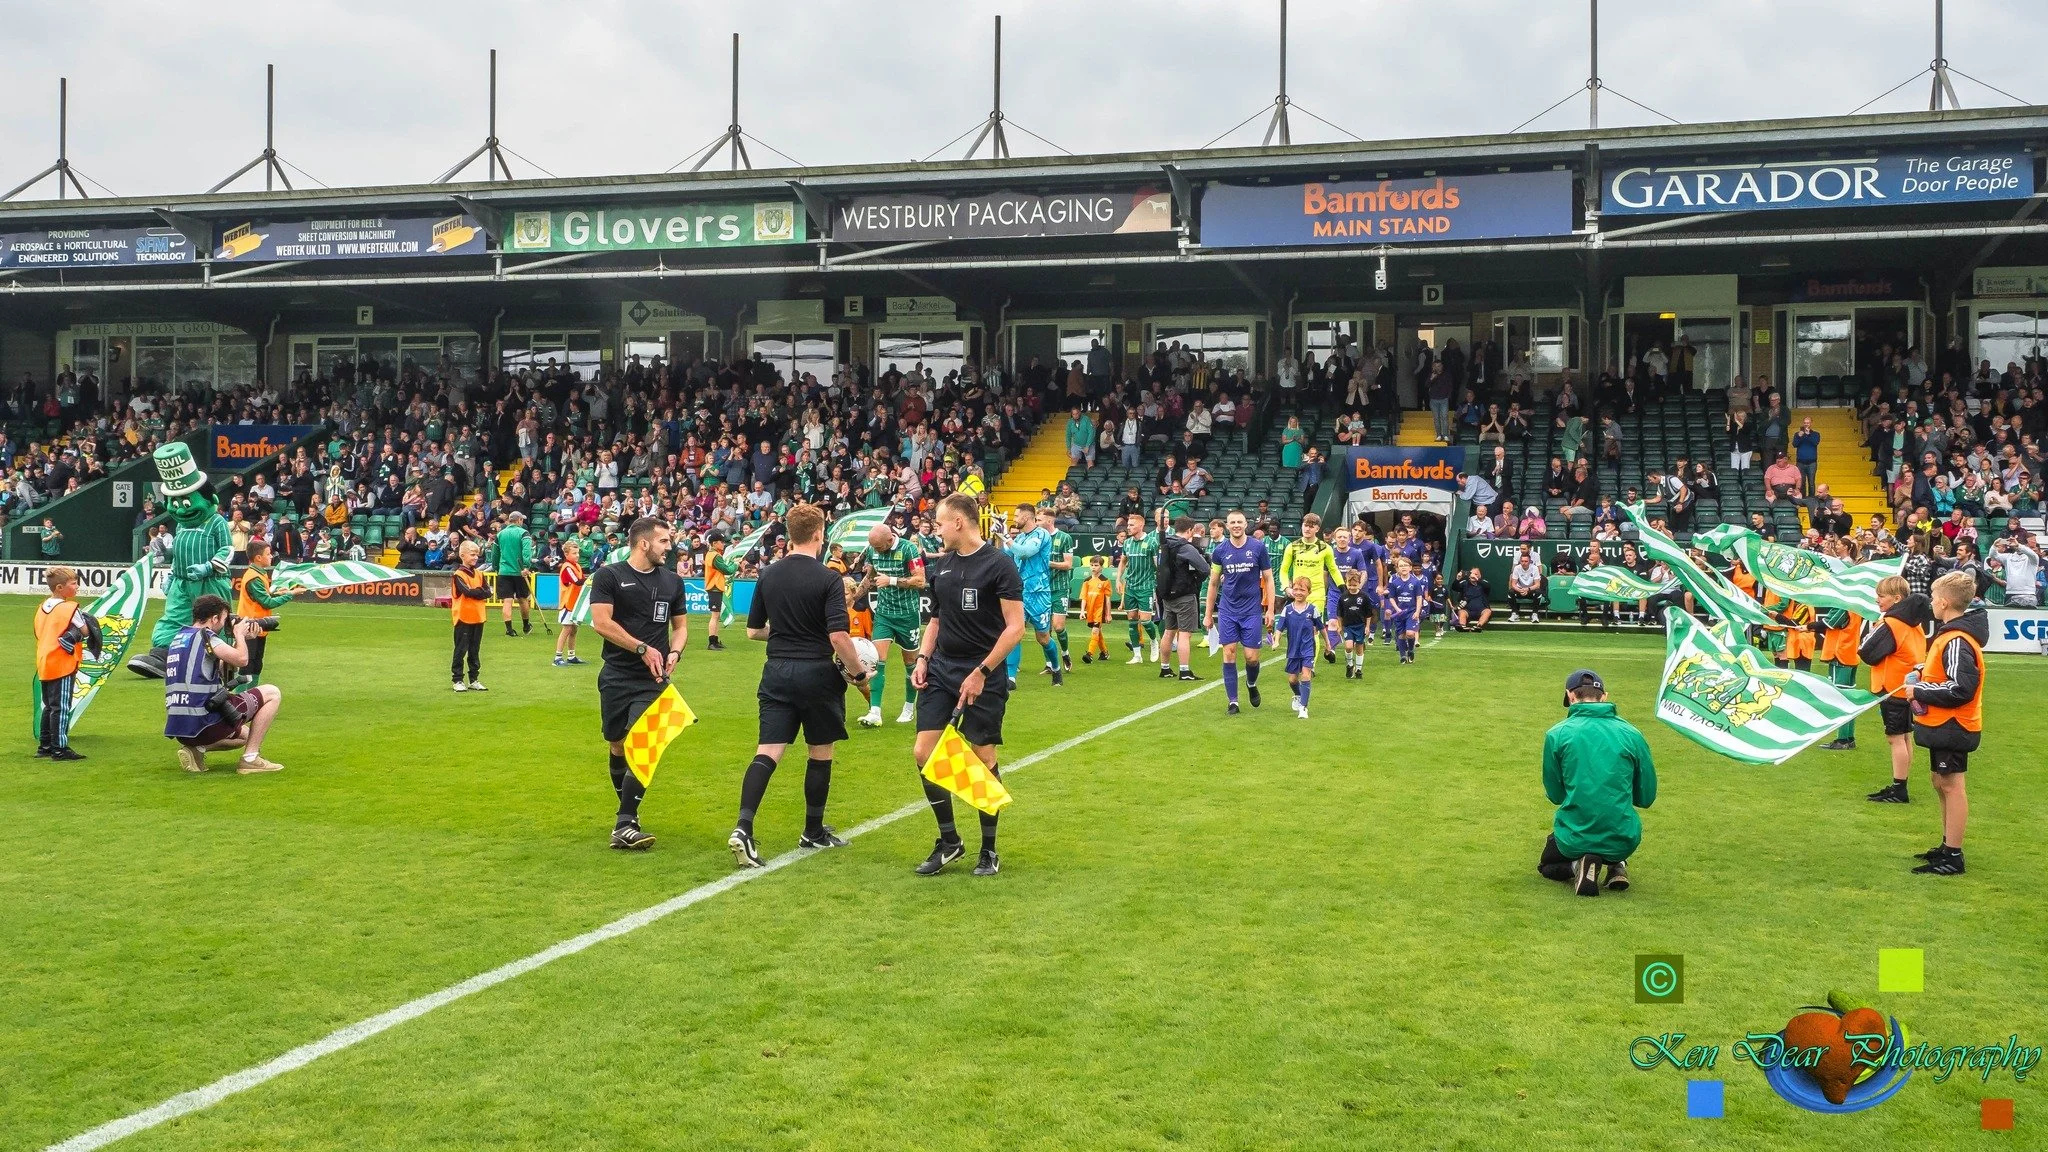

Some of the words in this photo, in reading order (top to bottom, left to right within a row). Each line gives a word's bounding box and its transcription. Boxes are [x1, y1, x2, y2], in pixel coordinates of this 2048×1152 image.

[1905, 158, 1939, 174] The
[1946, 155, 2013, 175] Garage
[1611, 167, 1887, 208] GARADOR
[1902, 176, 1950, 194] Door
[1955, 173, 2018, 194] People
[1303, 178, 1460, 215] Bamfords
[841, 203, 960, 230] WESTBURY
[968, 197, 1114, 227] PACKAGING
[311, 219, 347, 230] EQUIPMENT
[347, 219, 360, 229] FOR
[361, 219, 376, 228] REEL
[377, 218, 383, 228] &
[434, 216, 461, 237] WEBTEK
[563, 210, 741, 246] Glovers
[1312, 219, 1372, 238] MAIN
[1379, 216, 1451, 236] STAND
[48, 230, 90, 239] PROVIDING
[224, 224, 250, 244] WEBTEK
[298, 232, 317, 242] SHEET
[318, 231, 358, 242] CONVERSION
[358, 230, 396, 240] MACHINERY
[10, 241, 54, 252] AEROSPACE
[64, 240, 128, 250] HORTICULTURAL
[136, 237, 169, 253] SFM
[276, 245, 305, 256] WEBTEK
[306, 245, 317, 256] UK
[318, 244, 331, 255] LTD
[337, 241, 419, 255] WWW.WEBTEKUK.COM
[18, 253, 68, 263] ENGINEERED
[72, 252, 119, 262] SOLUTIONS
[136, 252, 186, 262] TECHNOLOGY
[1427, 287, 1440, 302] D
[849, 301, 859, 312] E
[361, 310, 369, 321] F
[84, 324, 111, 335] THE
[116, 323, 144, 335] END
[150, 323, 176, 334] BOX
[157, 455, 186, 468] EOVIL
[1355, 458, 1454, 480] Bamfords
[162, 467, 184, 479] OWN
[119, 492, 127, 504] 3
[1372, 488, 1428, 501] Bamfords
[1661, 700, 1686, 717] TOWN
[1689, 711, 1732, 734] YEOVIL
